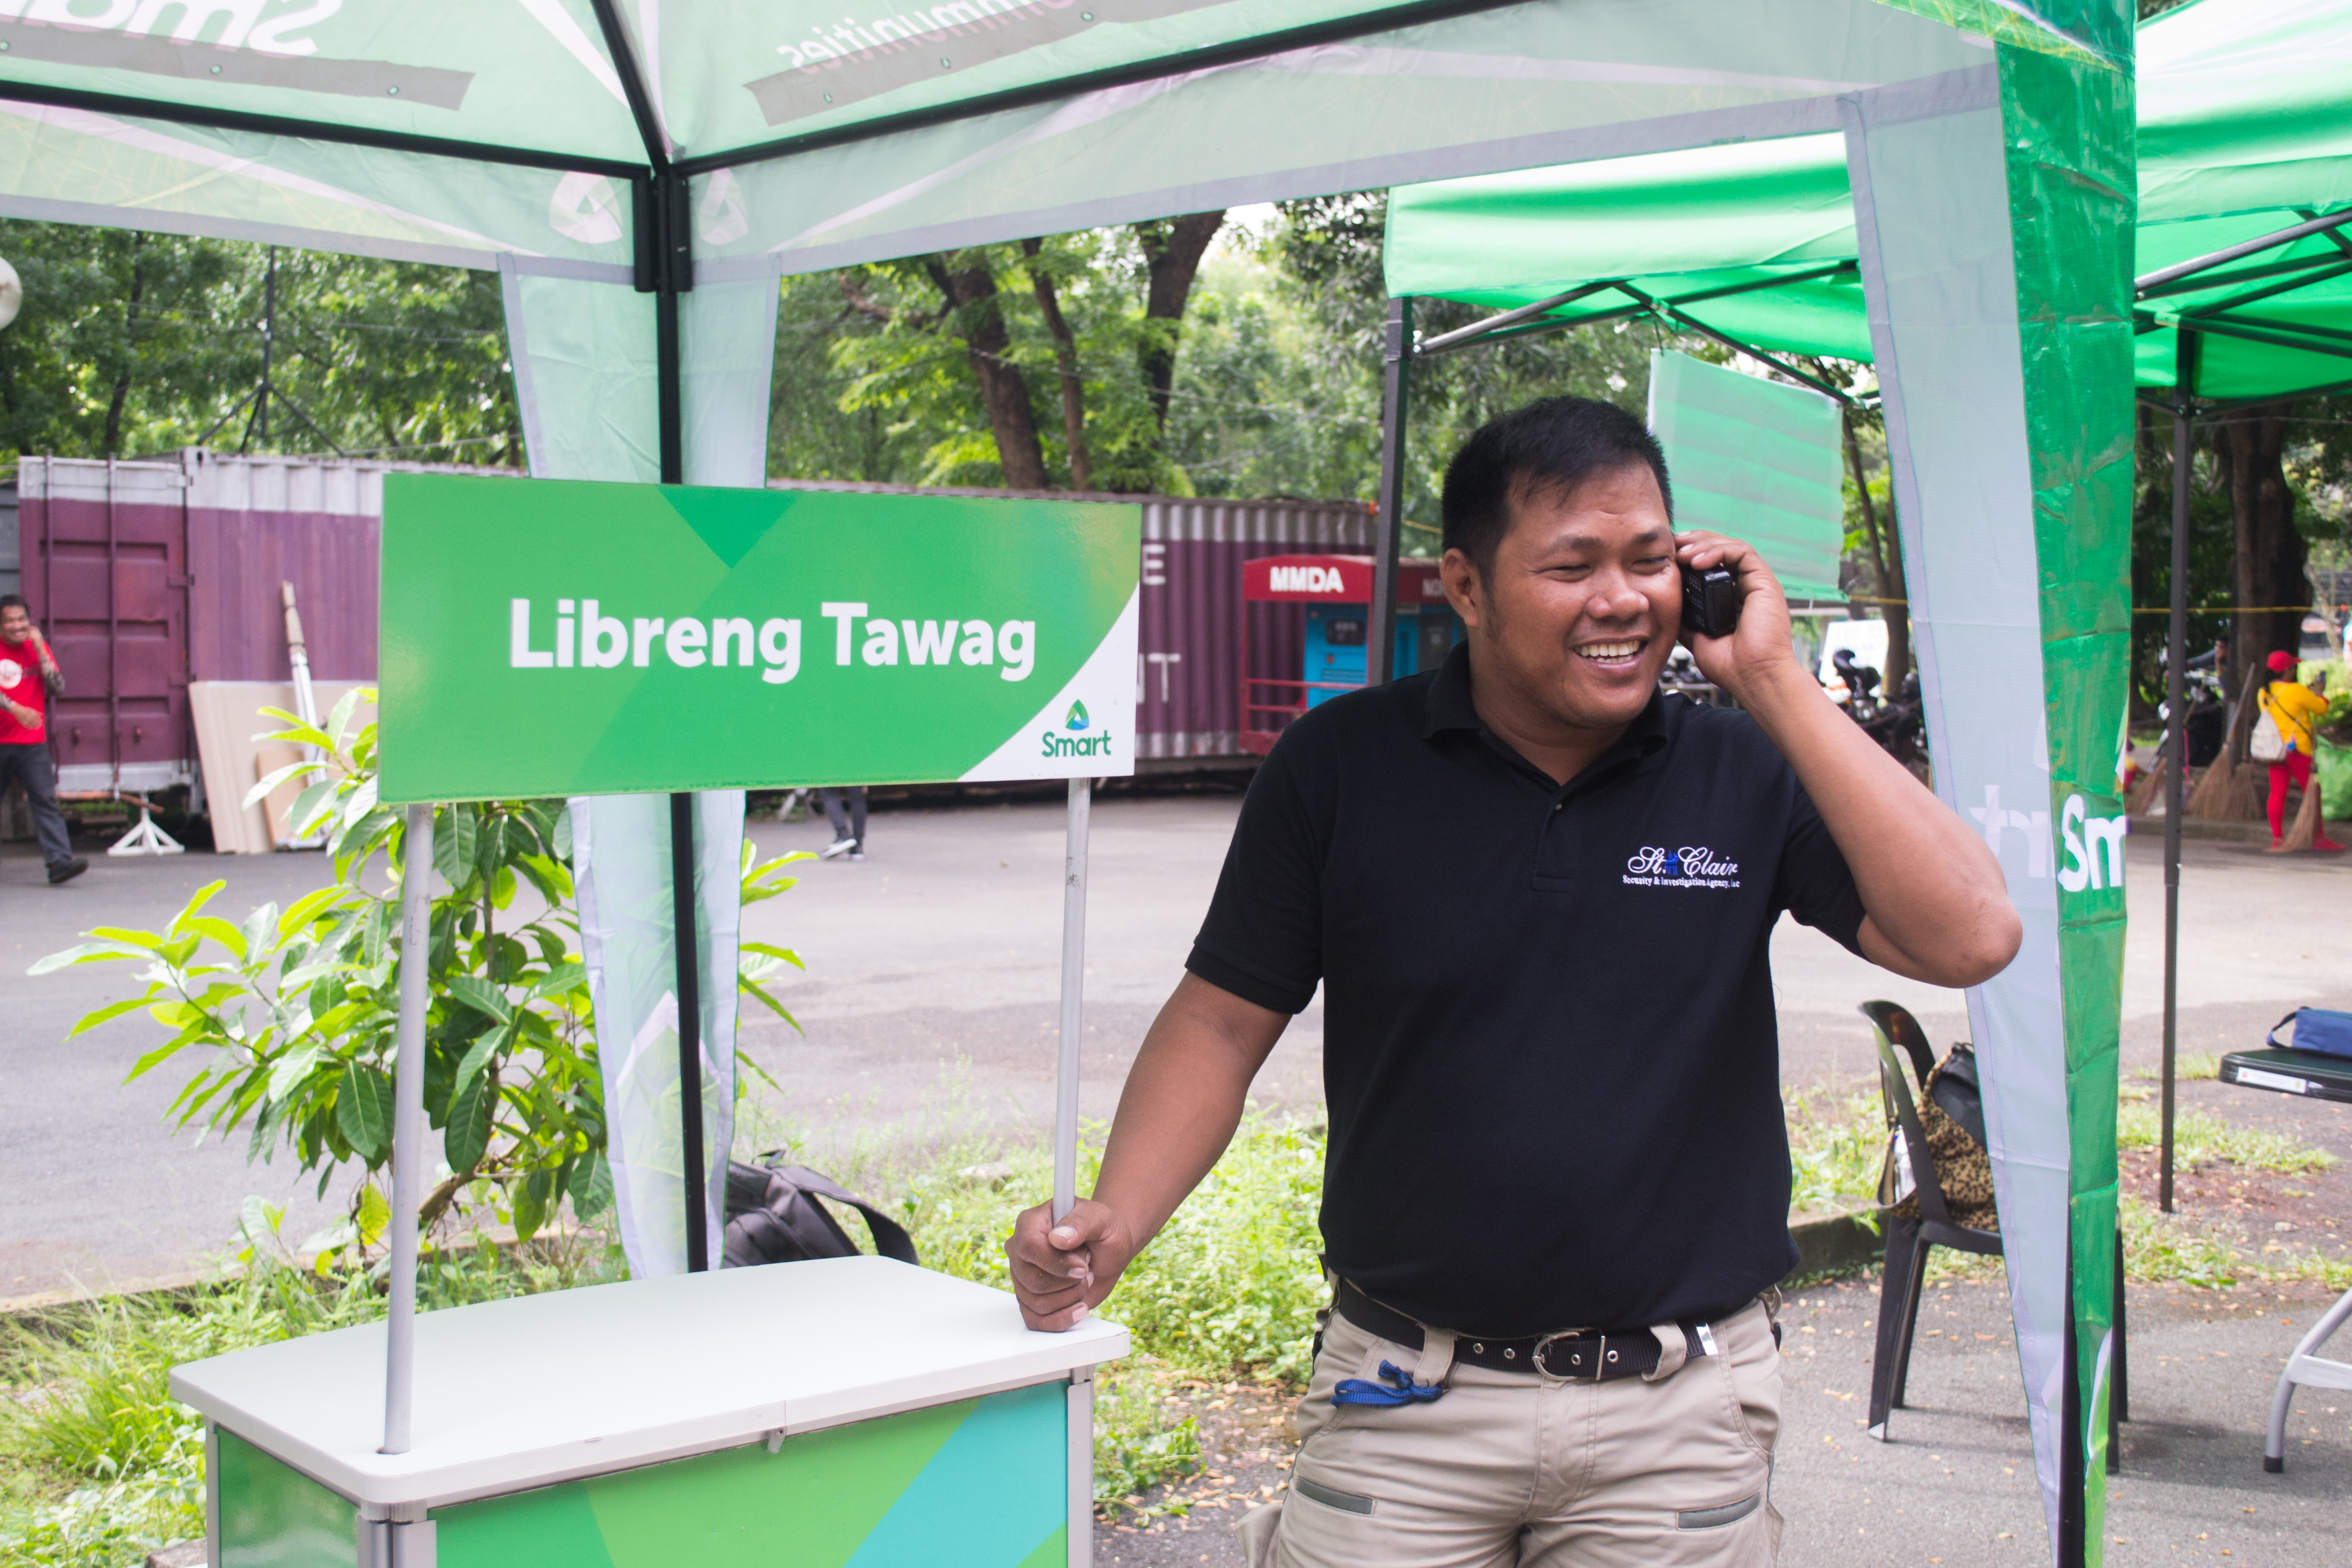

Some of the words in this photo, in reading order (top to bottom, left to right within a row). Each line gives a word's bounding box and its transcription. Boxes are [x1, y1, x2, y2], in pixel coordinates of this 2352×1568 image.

[1269, 567, 1344, 593] MMDA
[511, 598, 802, 684] Libreng
[821, 601, 1036, 682] Tawag
[1042, 730, 1112, 757] Smart
[1627, 846, 1667, 874] St.
[1677, 846, 1738, 877] Clair
[1622, 874, 1653, 887] Security
[1661, 876, 1706, 888] Investigation
